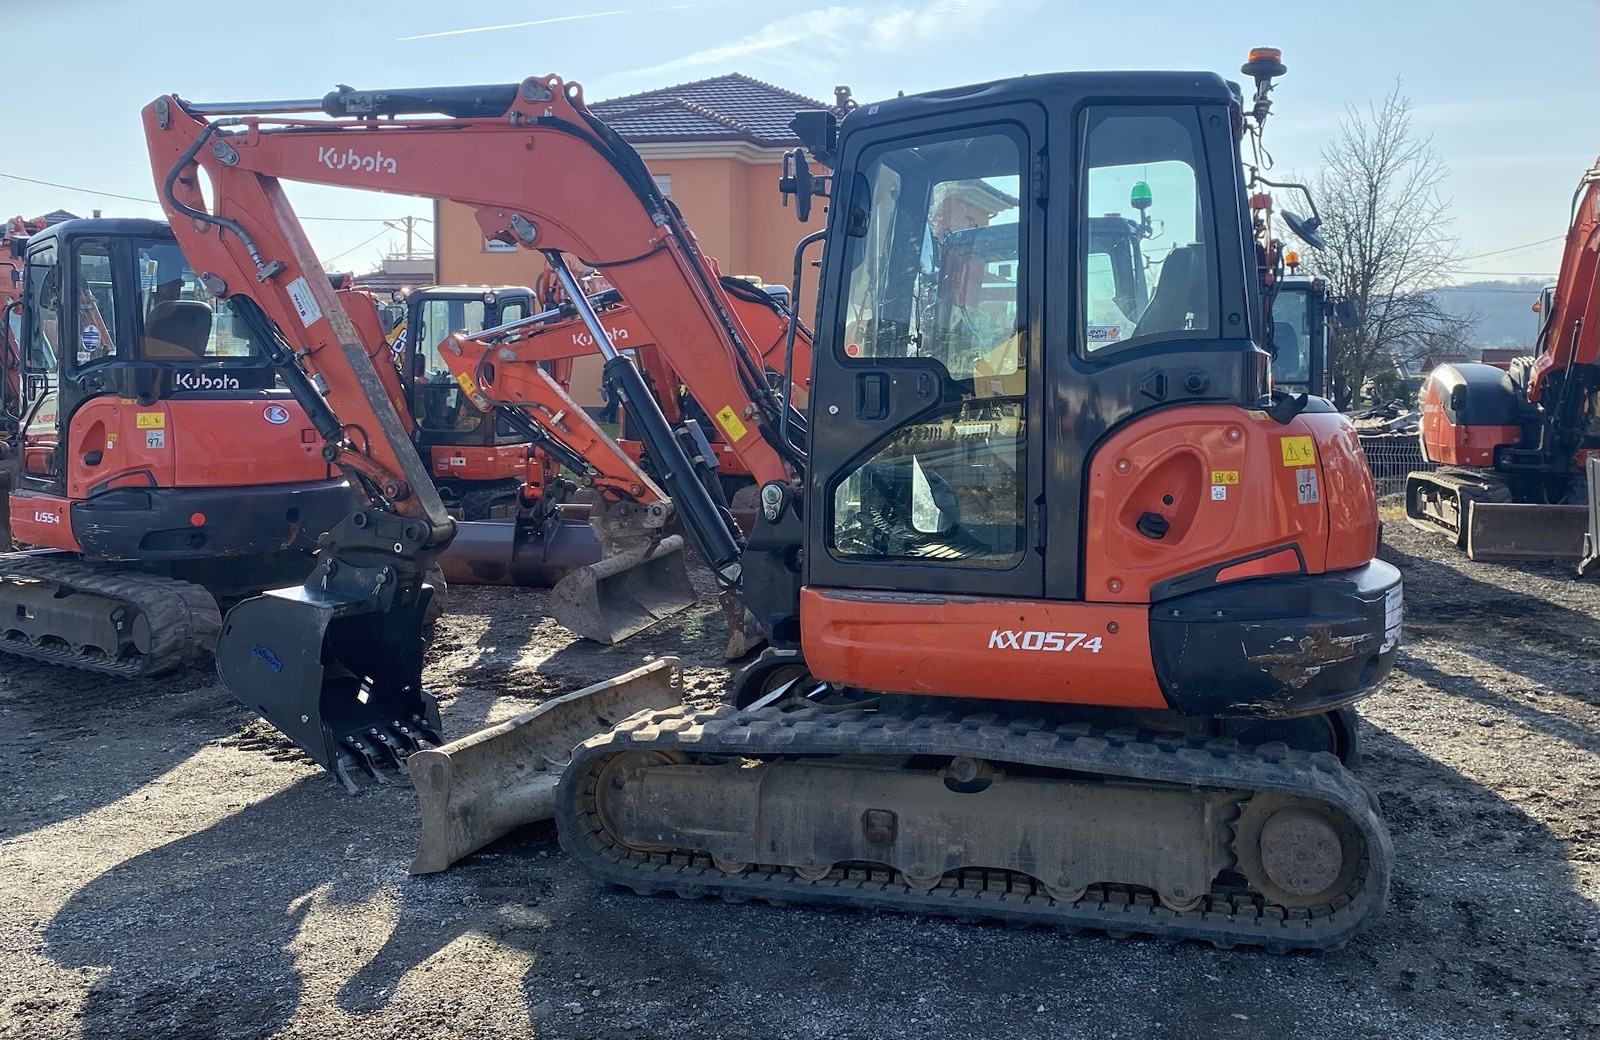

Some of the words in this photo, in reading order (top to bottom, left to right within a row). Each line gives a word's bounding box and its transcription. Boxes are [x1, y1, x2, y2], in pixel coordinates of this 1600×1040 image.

[318, 146, 397, 174] Kubota
[572, 327, 629, 346] Kuota
[176, 373, 240, 389] Kubota
[148, 437, 160, 448] 97
[1299, 484, 1312, 501] 97
[988, 629, 1103, 653] KX057-4
